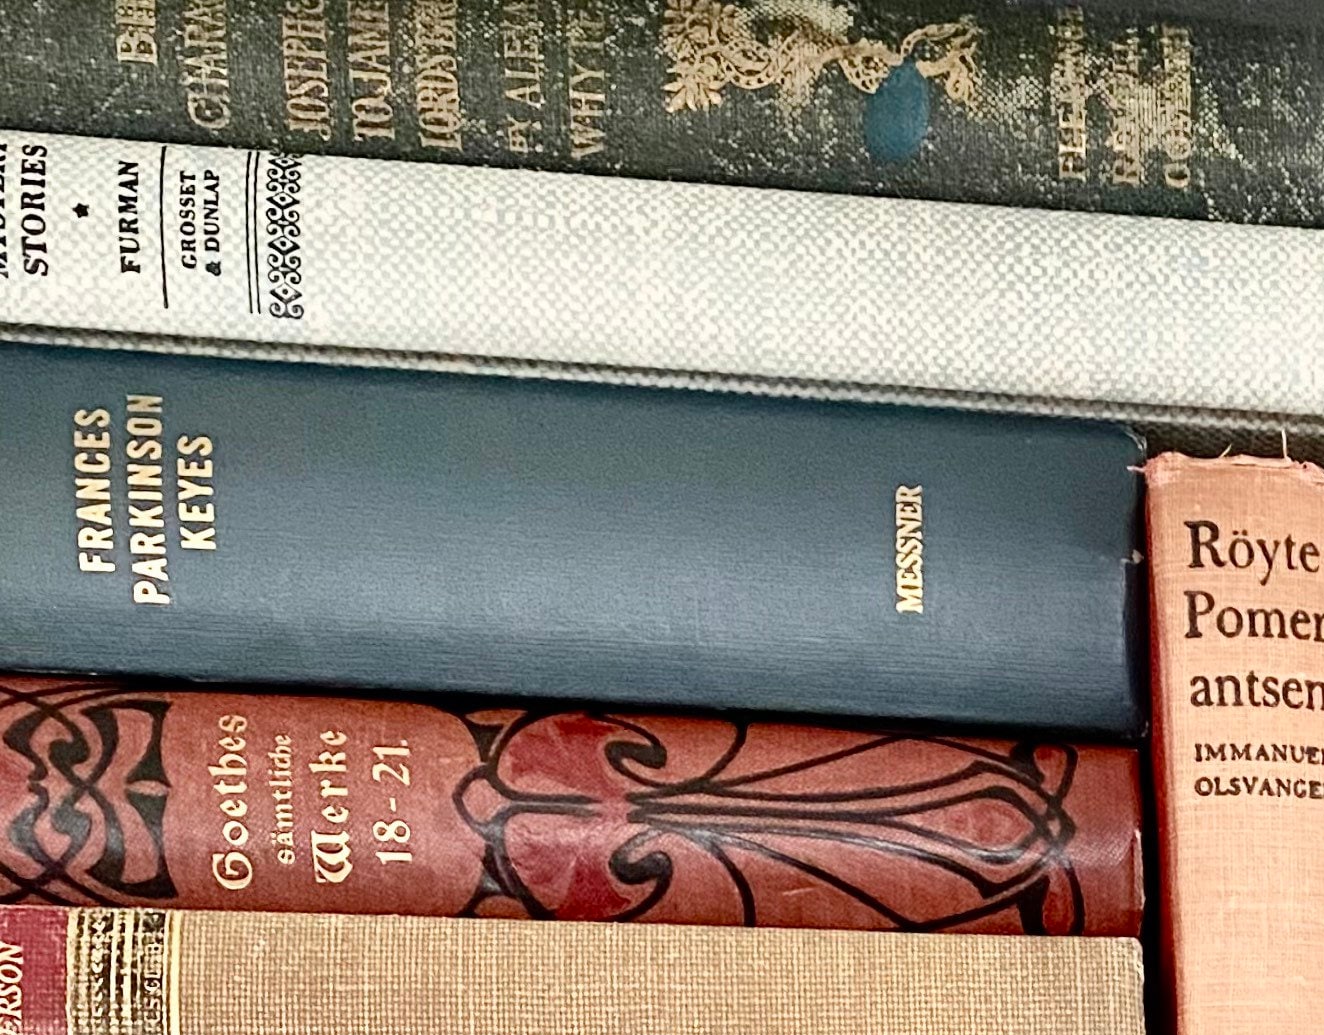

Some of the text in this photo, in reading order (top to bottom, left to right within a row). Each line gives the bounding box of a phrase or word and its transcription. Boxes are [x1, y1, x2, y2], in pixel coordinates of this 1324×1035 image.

[20, 144, 49, 277] STORIES
[117, 160, 141, 275] FURMAN
[178, 170, 198, 270] GROSSET
[203, 169, 222, 277] & DUNLAP
[73, 408, 116, 573] FRANCES
[126, 394, 171, 605] PARKINSON
[176, 435, 217, 550] KEYES
[895, 484, 924, 614] MESSNER
[1183, 519, 1321, 586] Röyte
[207, 714, 253, 890] Goethes
[268, 734, 296, 865] sämtliche
[308, 730, 353, 884] Werke
